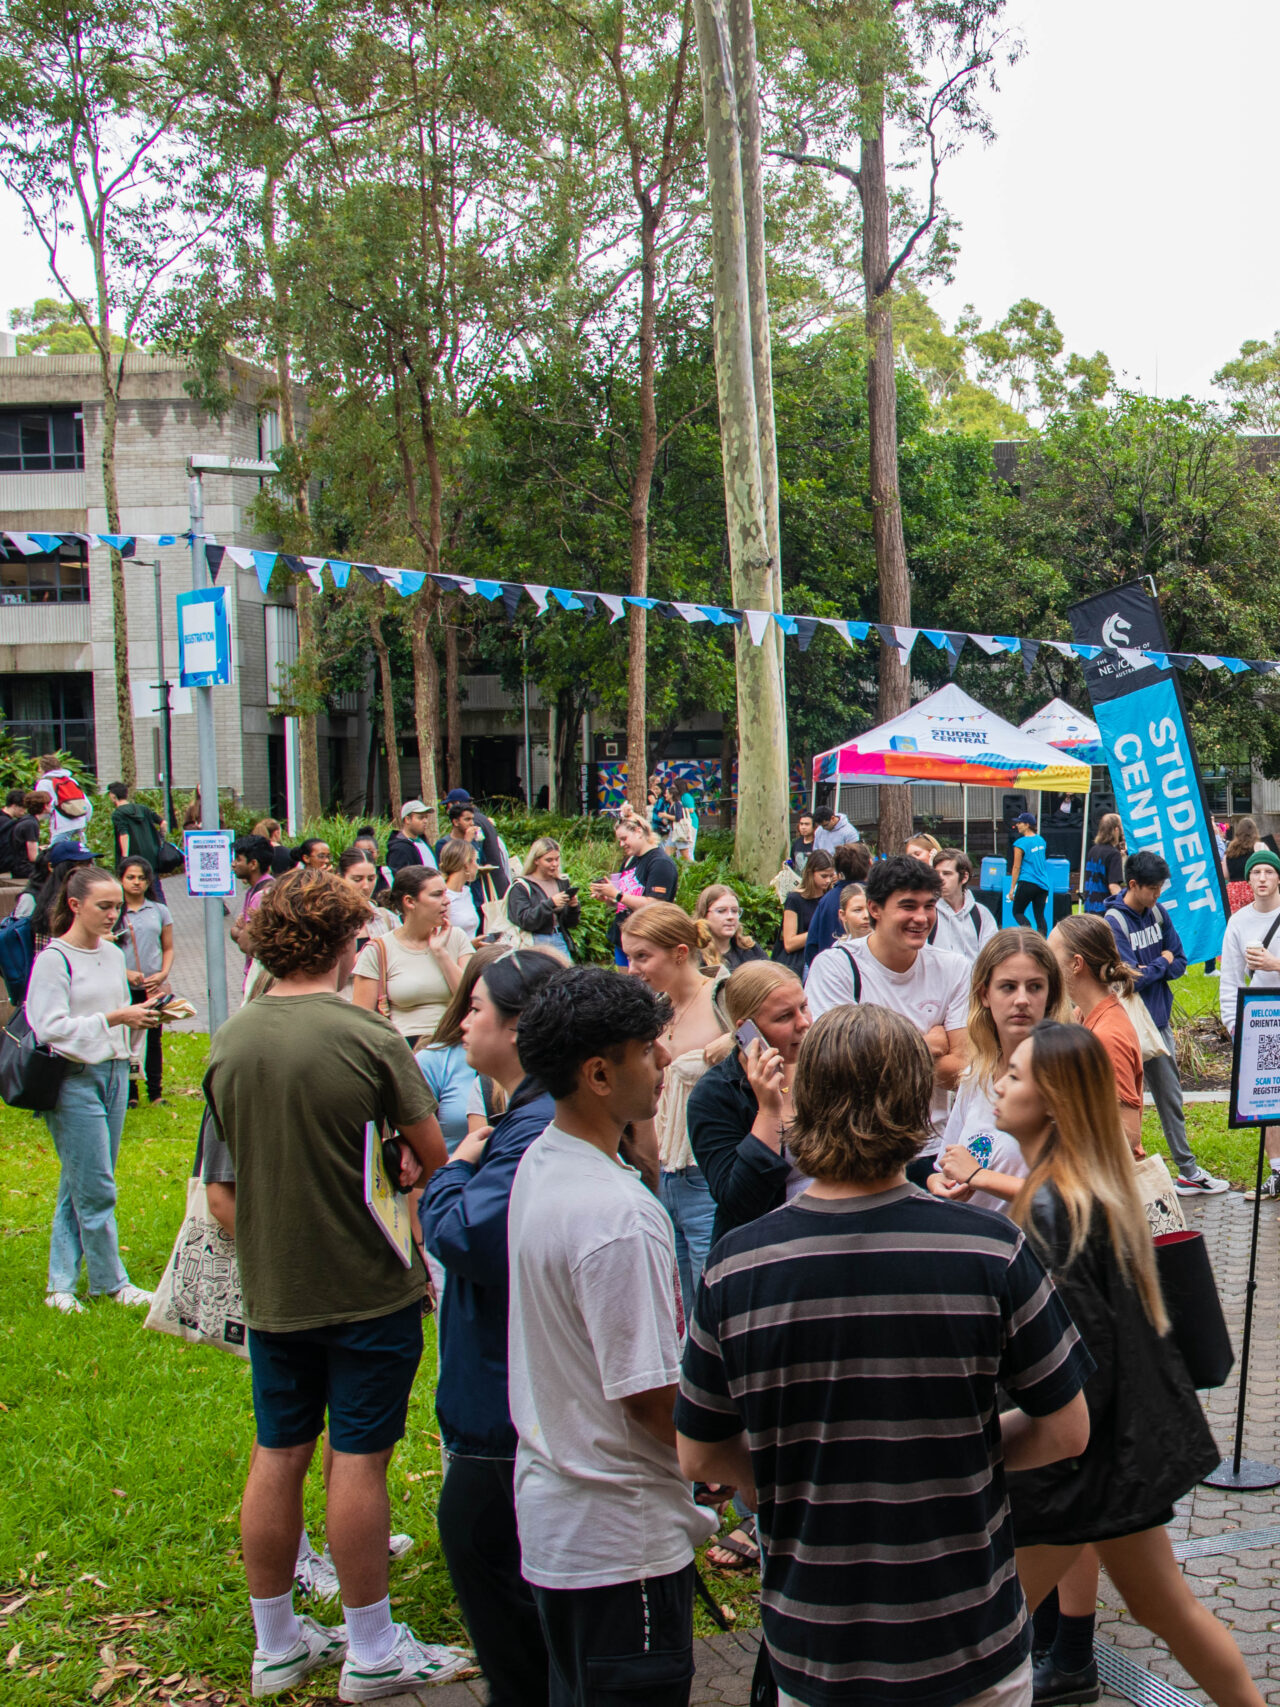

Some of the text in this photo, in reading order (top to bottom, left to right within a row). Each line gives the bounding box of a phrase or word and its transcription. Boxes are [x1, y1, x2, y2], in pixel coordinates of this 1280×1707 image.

[1097, 658, 1108, 666] THE
[1115, 667, 1136, 679] AUSTRA
[931, 729, 989, 738] STUDENT
[932, 735, 990, 744] CENTRAL
[1149, 717, 1217, 913] STUDENT
[1114, 733, 1179, 911] CENT
[1255, 1076, 1280, 1086] SCAN TO
